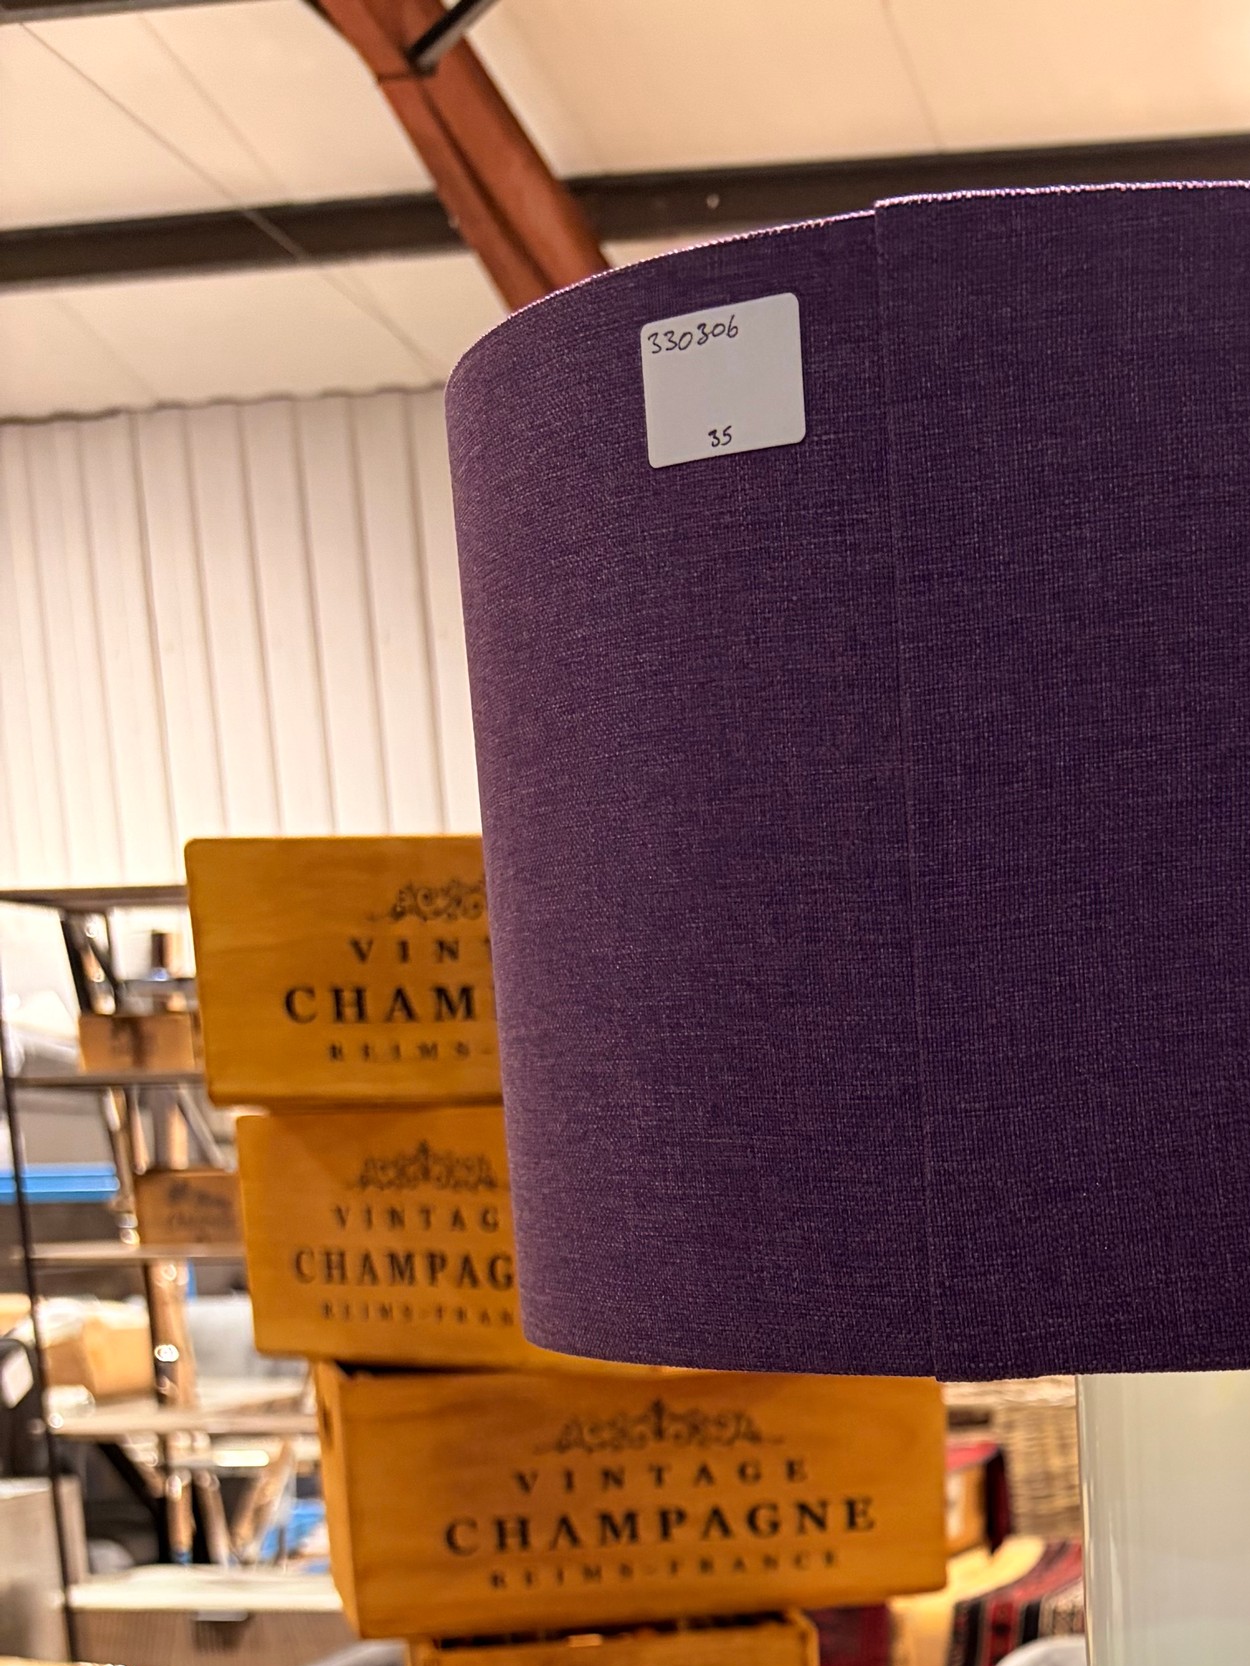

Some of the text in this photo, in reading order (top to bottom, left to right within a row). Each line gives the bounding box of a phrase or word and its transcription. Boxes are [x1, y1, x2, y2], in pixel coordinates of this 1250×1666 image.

[647, 314, 739, 354] 330306
[707, 425, 733, 448] 35
[348, 936, 491, 964] VIN
[283, 983, 478, 1024] CHAM
[333, 1204, 500, 1233] VINTAG
[293, 1247, 514, 1292] CHAMPAG
[512, 1458, 809, 1495] VINTAGE
[443, 1496, 877, 1557] CHAMPAGNE
